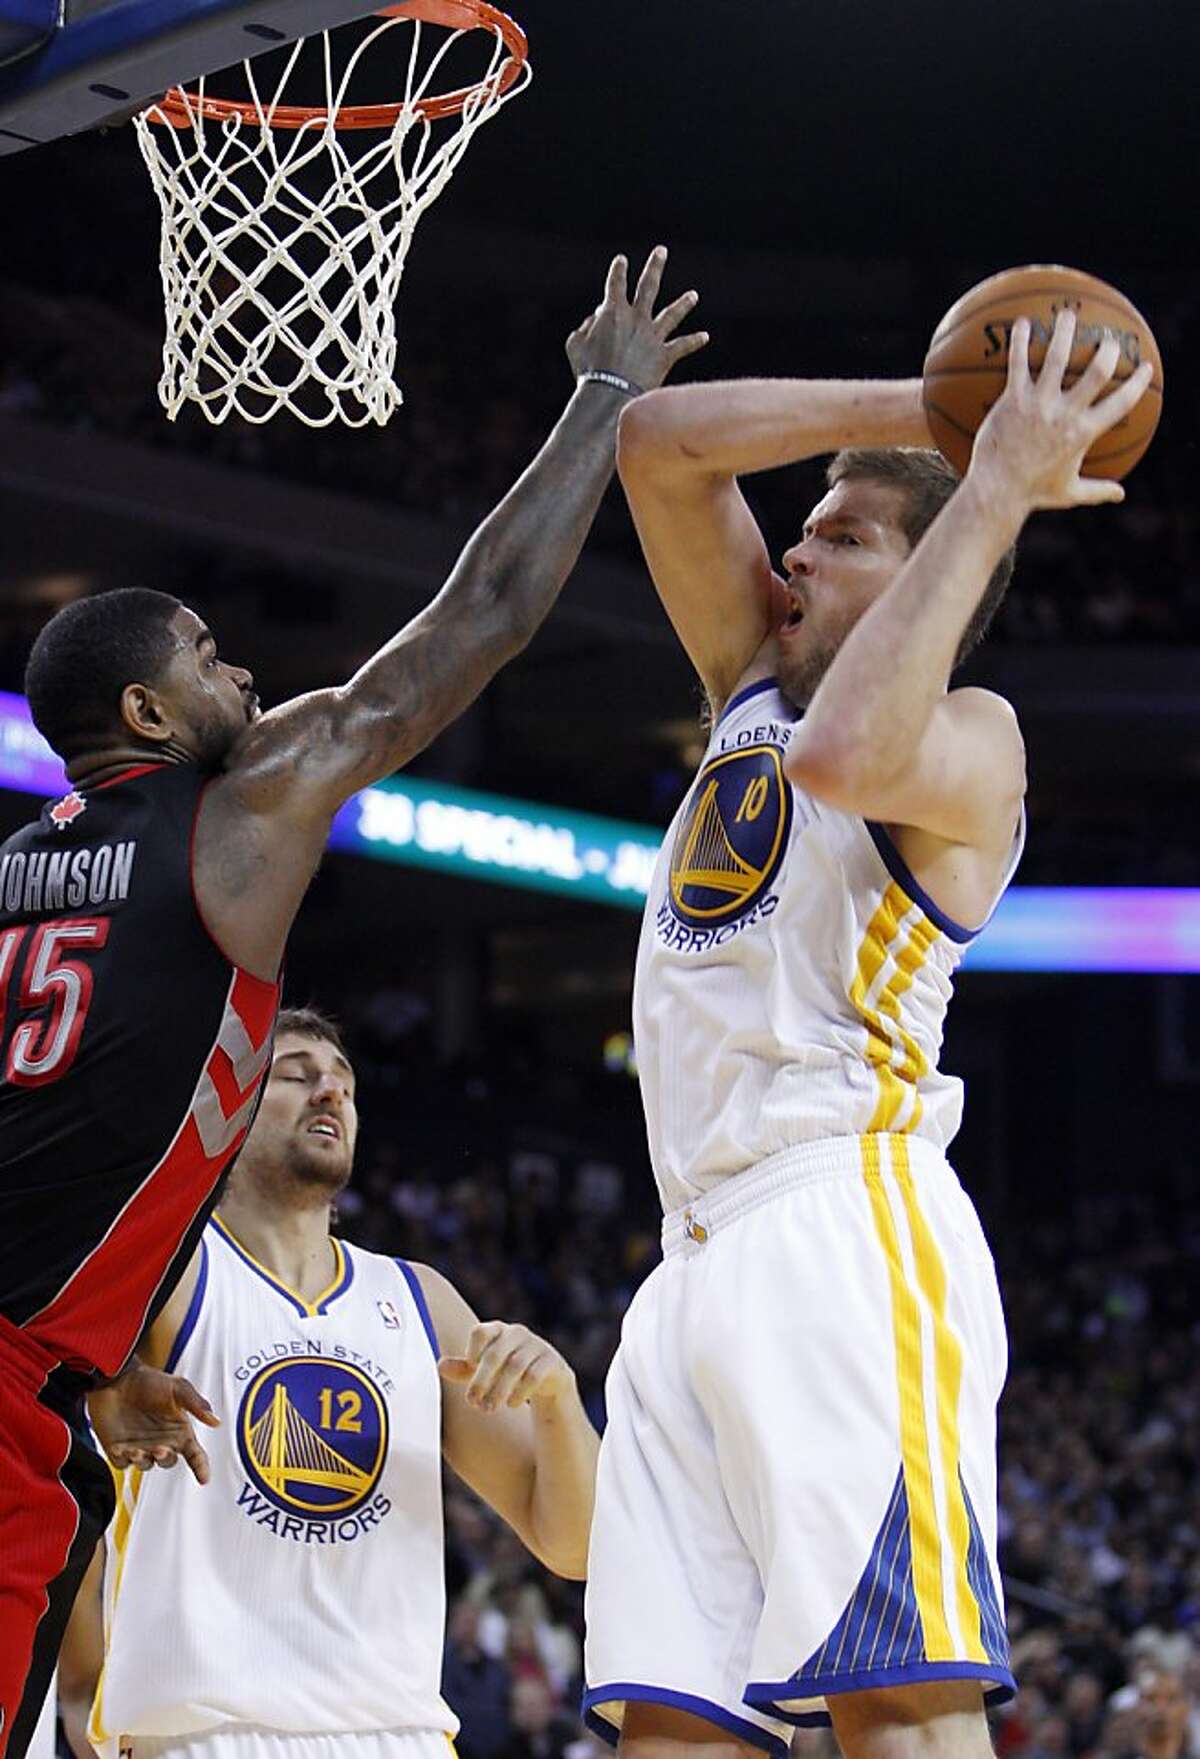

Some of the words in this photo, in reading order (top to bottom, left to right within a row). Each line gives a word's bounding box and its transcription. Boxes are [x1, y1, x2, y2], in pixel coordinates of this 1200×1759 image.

[734, 775, 768, 823] 10
[234, 1340, 322, 1382] GOLDEN
[333, 1344, 396, 1396] STATE
[318, 1387, 363, 1434] 12
[234, 1481, 392, 1545] WARRIORS
